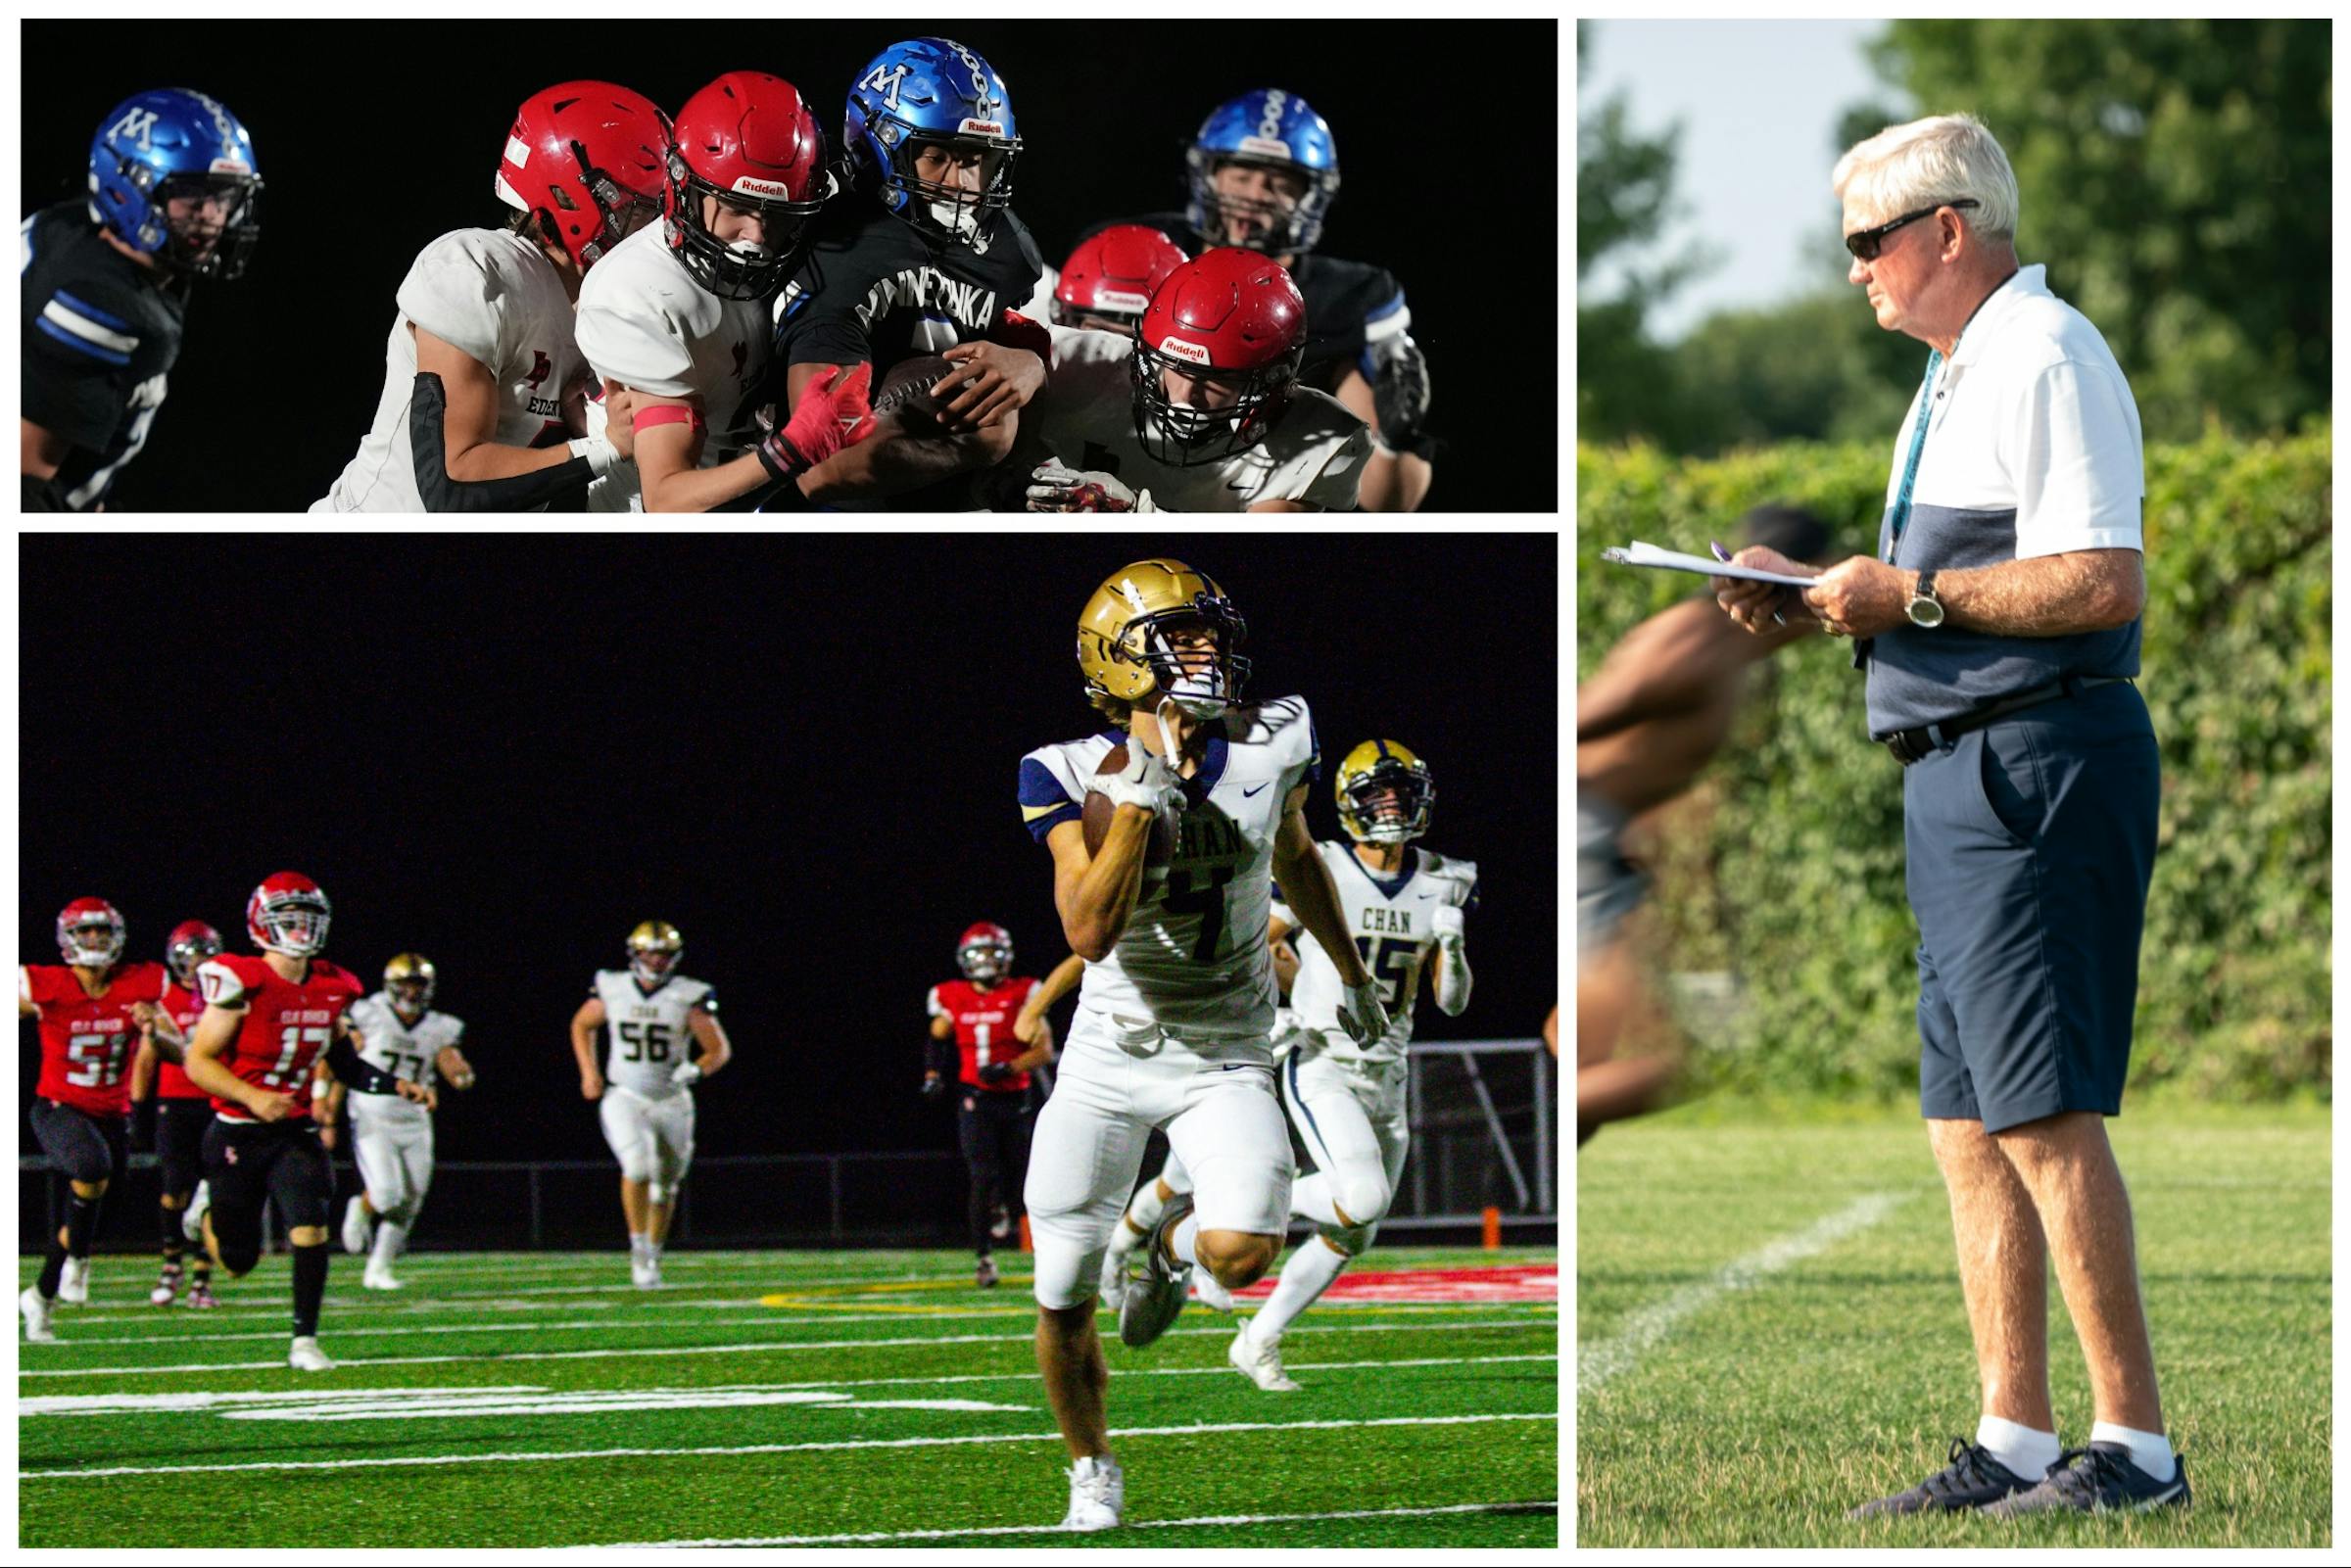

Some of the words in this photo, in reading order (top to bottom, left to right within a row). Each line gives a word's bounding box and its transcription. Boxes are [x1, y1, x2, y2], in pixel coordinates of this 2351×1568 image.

[858, 64, 910, 112] M
[107, 108, 159, 151] M
[968, 120, 1001, 134] Riddell
[742, 180, 785, 196] Riddell
[1166, 341, 1204, 358] Riddell
[1181, 820, 1242, 859] HAN
[1161, 867, 1235, 960] 4
[1363, 907, 1411, 933] CHAN
[67, 1034, 125, 1087] 51
[264, 1026, 331, 1089] 17
[619, 1022, 670, 1063] 56
[975, 1023, 989, 1067] 1
